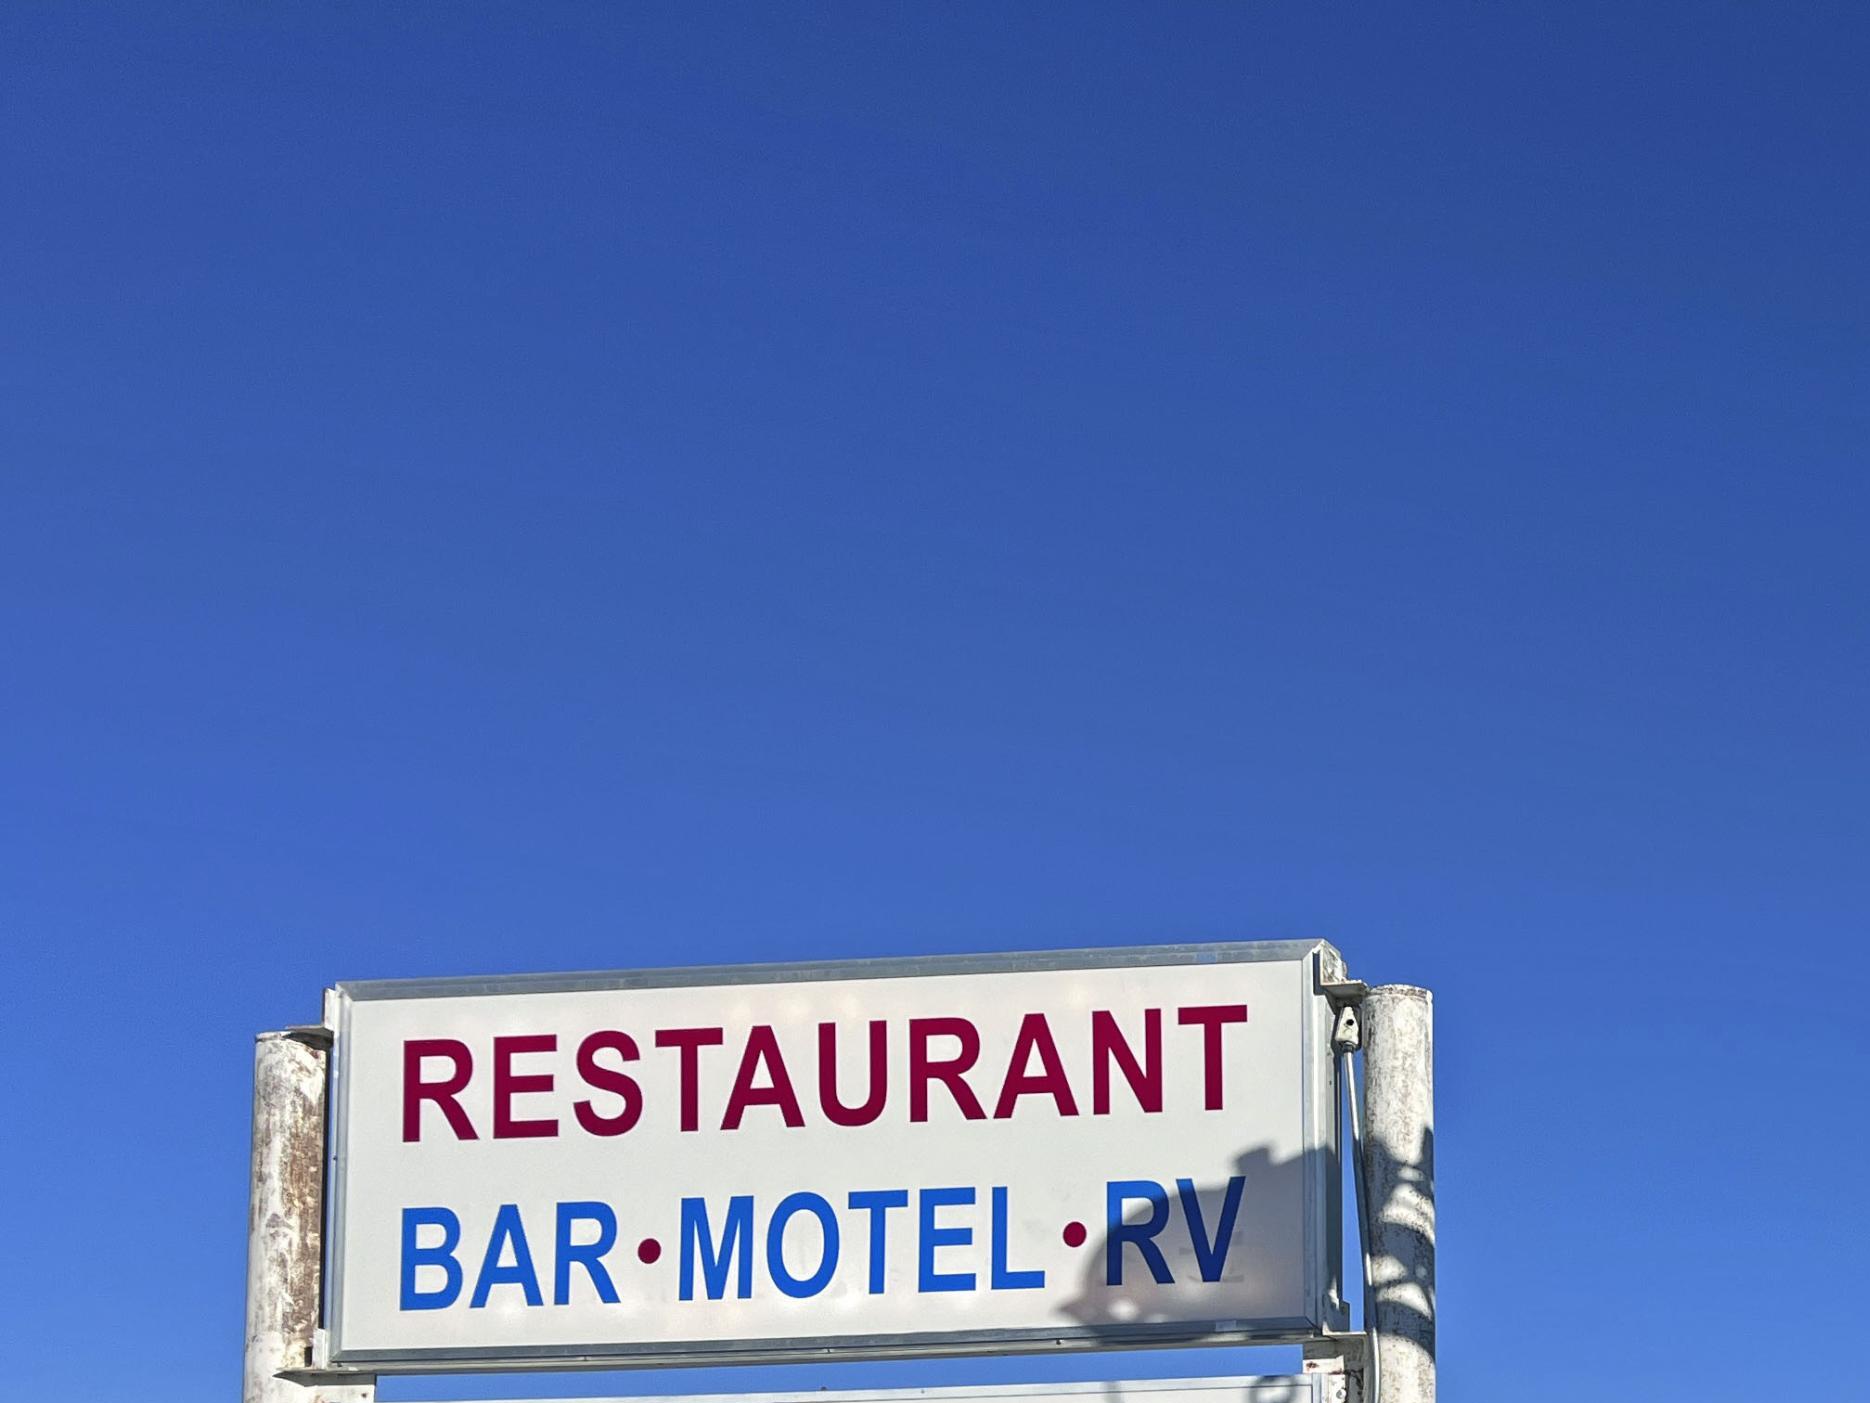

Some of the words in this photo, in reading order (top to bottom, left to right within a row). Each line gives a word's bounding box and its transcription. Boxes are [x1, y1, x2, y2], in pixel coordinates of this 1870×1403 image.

[401, 1004, 1248, 1143] RESTAURANT
[400, 1203, 621, 1312] BAR
[677, 1186, 1045, 1302] MOTEL
[1105, 1177, 1246, 1287] RV
